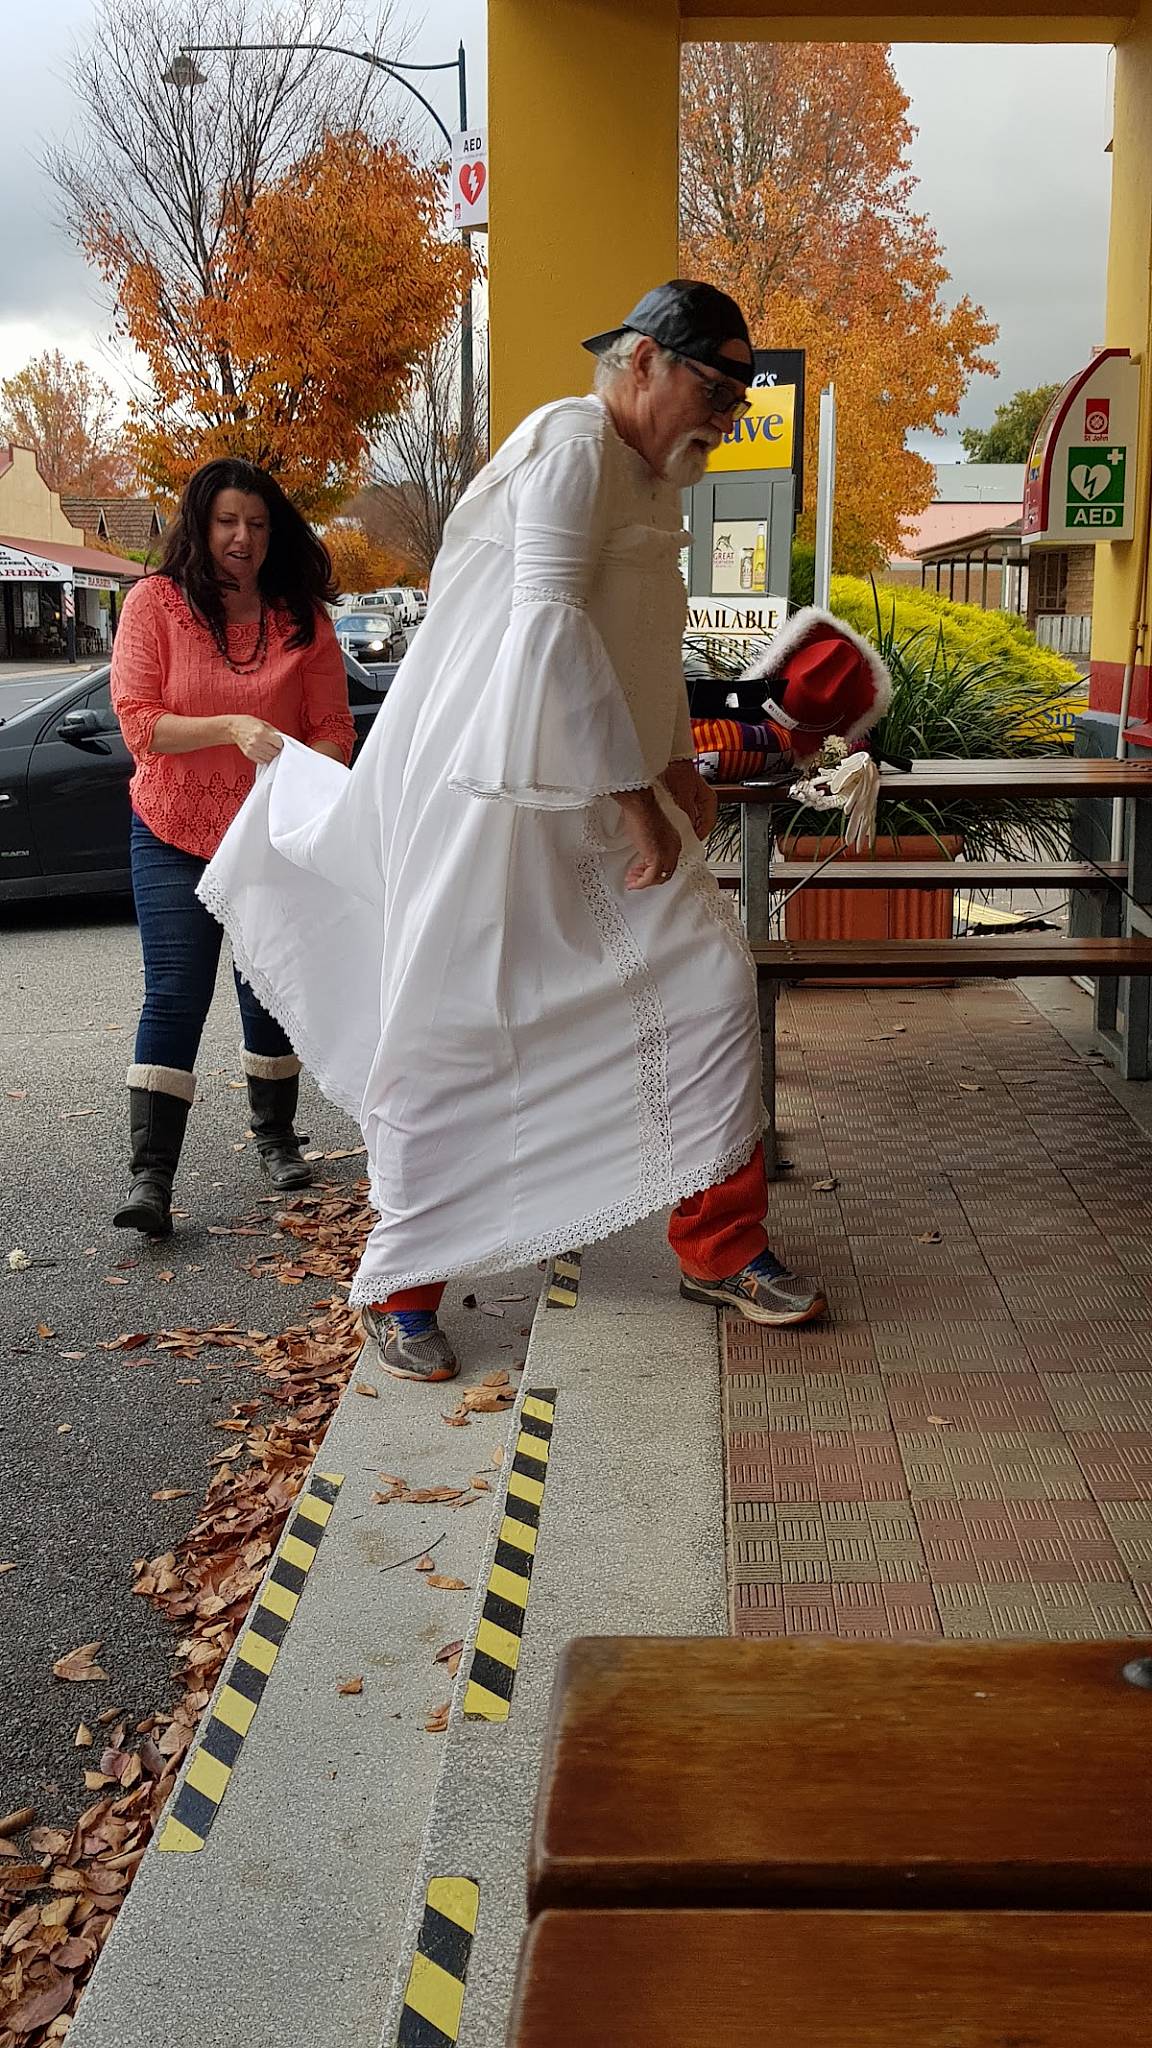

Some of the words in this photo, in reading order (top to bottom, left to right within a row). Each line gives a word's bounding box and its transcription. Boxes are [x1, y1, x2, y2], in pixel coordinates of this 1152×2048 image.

[463, 137, 482, 153] AED
[1073, 508, 1117, 525] AED
[713, 552, 735, 560] GREAT
